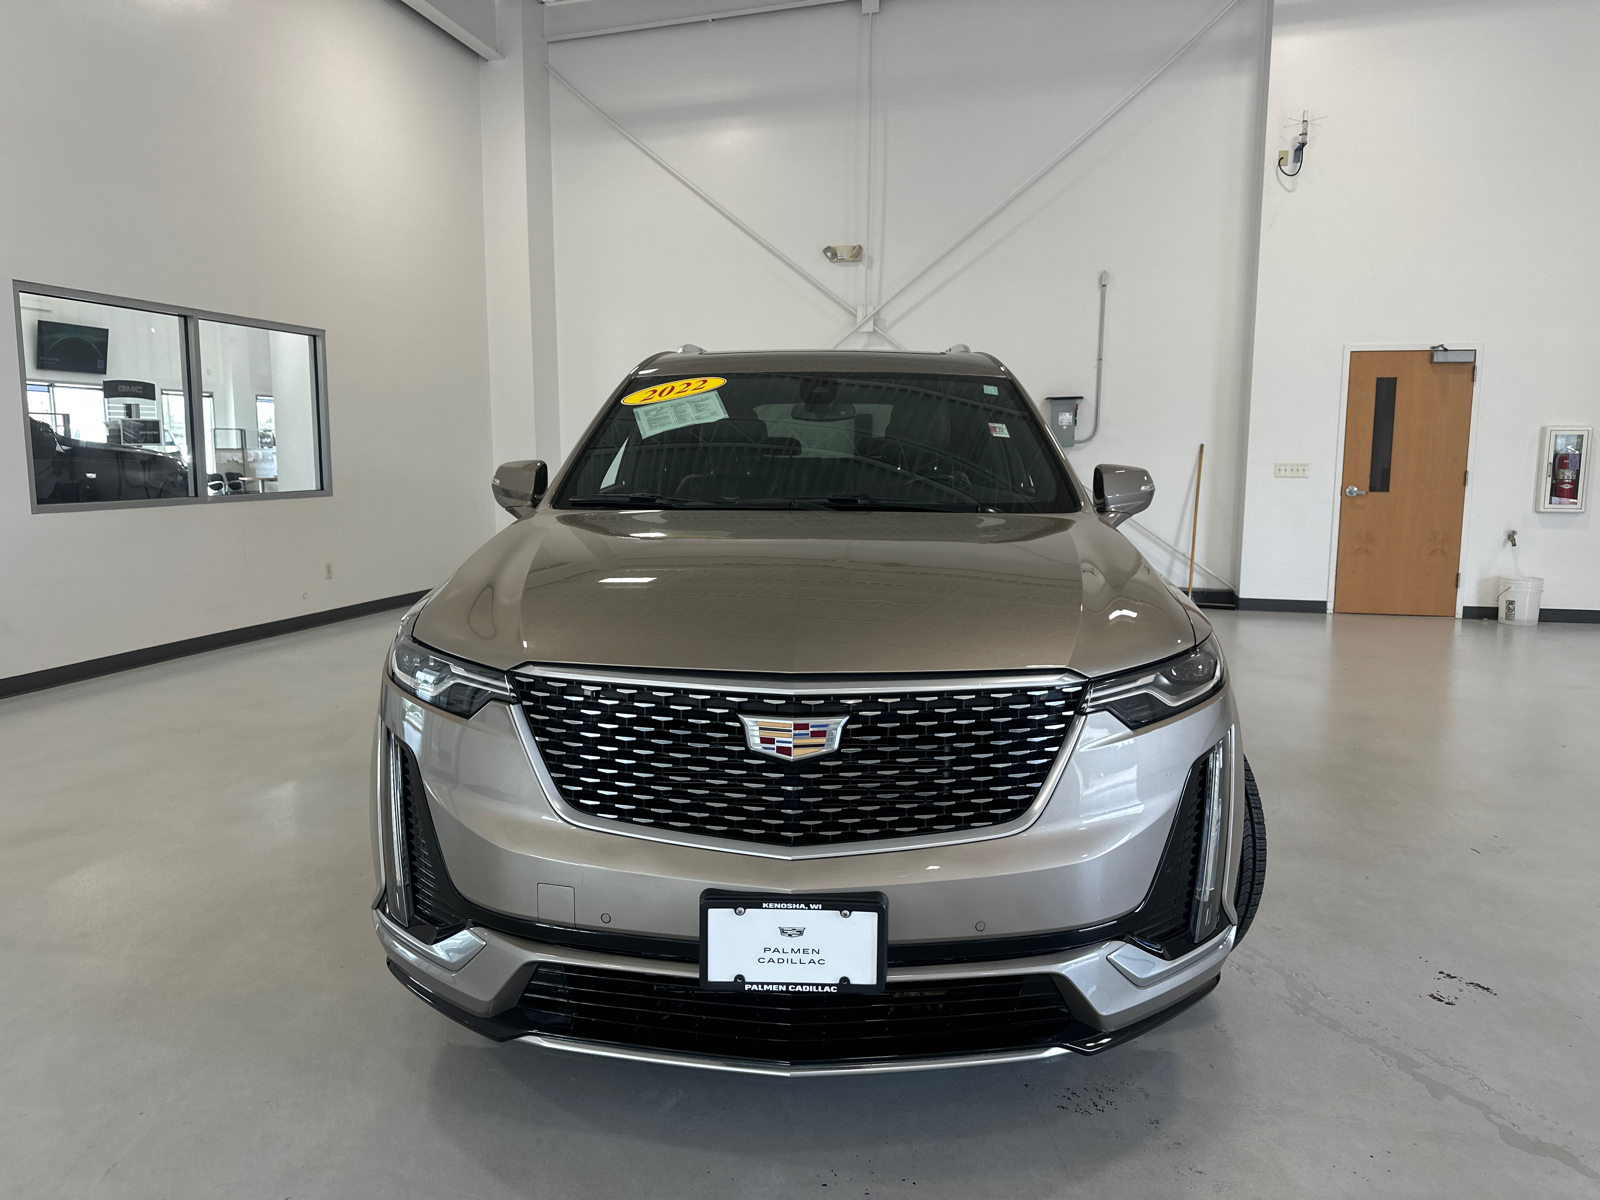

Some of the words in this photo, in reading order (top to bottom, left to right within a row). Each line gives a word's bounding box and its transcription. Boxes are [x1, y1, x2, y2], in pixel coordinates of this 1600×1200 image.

[118, 385, 143, 393] GMC
[640, 379, 708, 402] 2022
[762, 902, 808, 910] KENOSHA,
[763, 947, 820, 955] PALMEN
[757, 957, 826, 965] CADILLAC
[745, 984, 786, 992] PALMEN
[788, 985, 838, 993] CADILLAC
